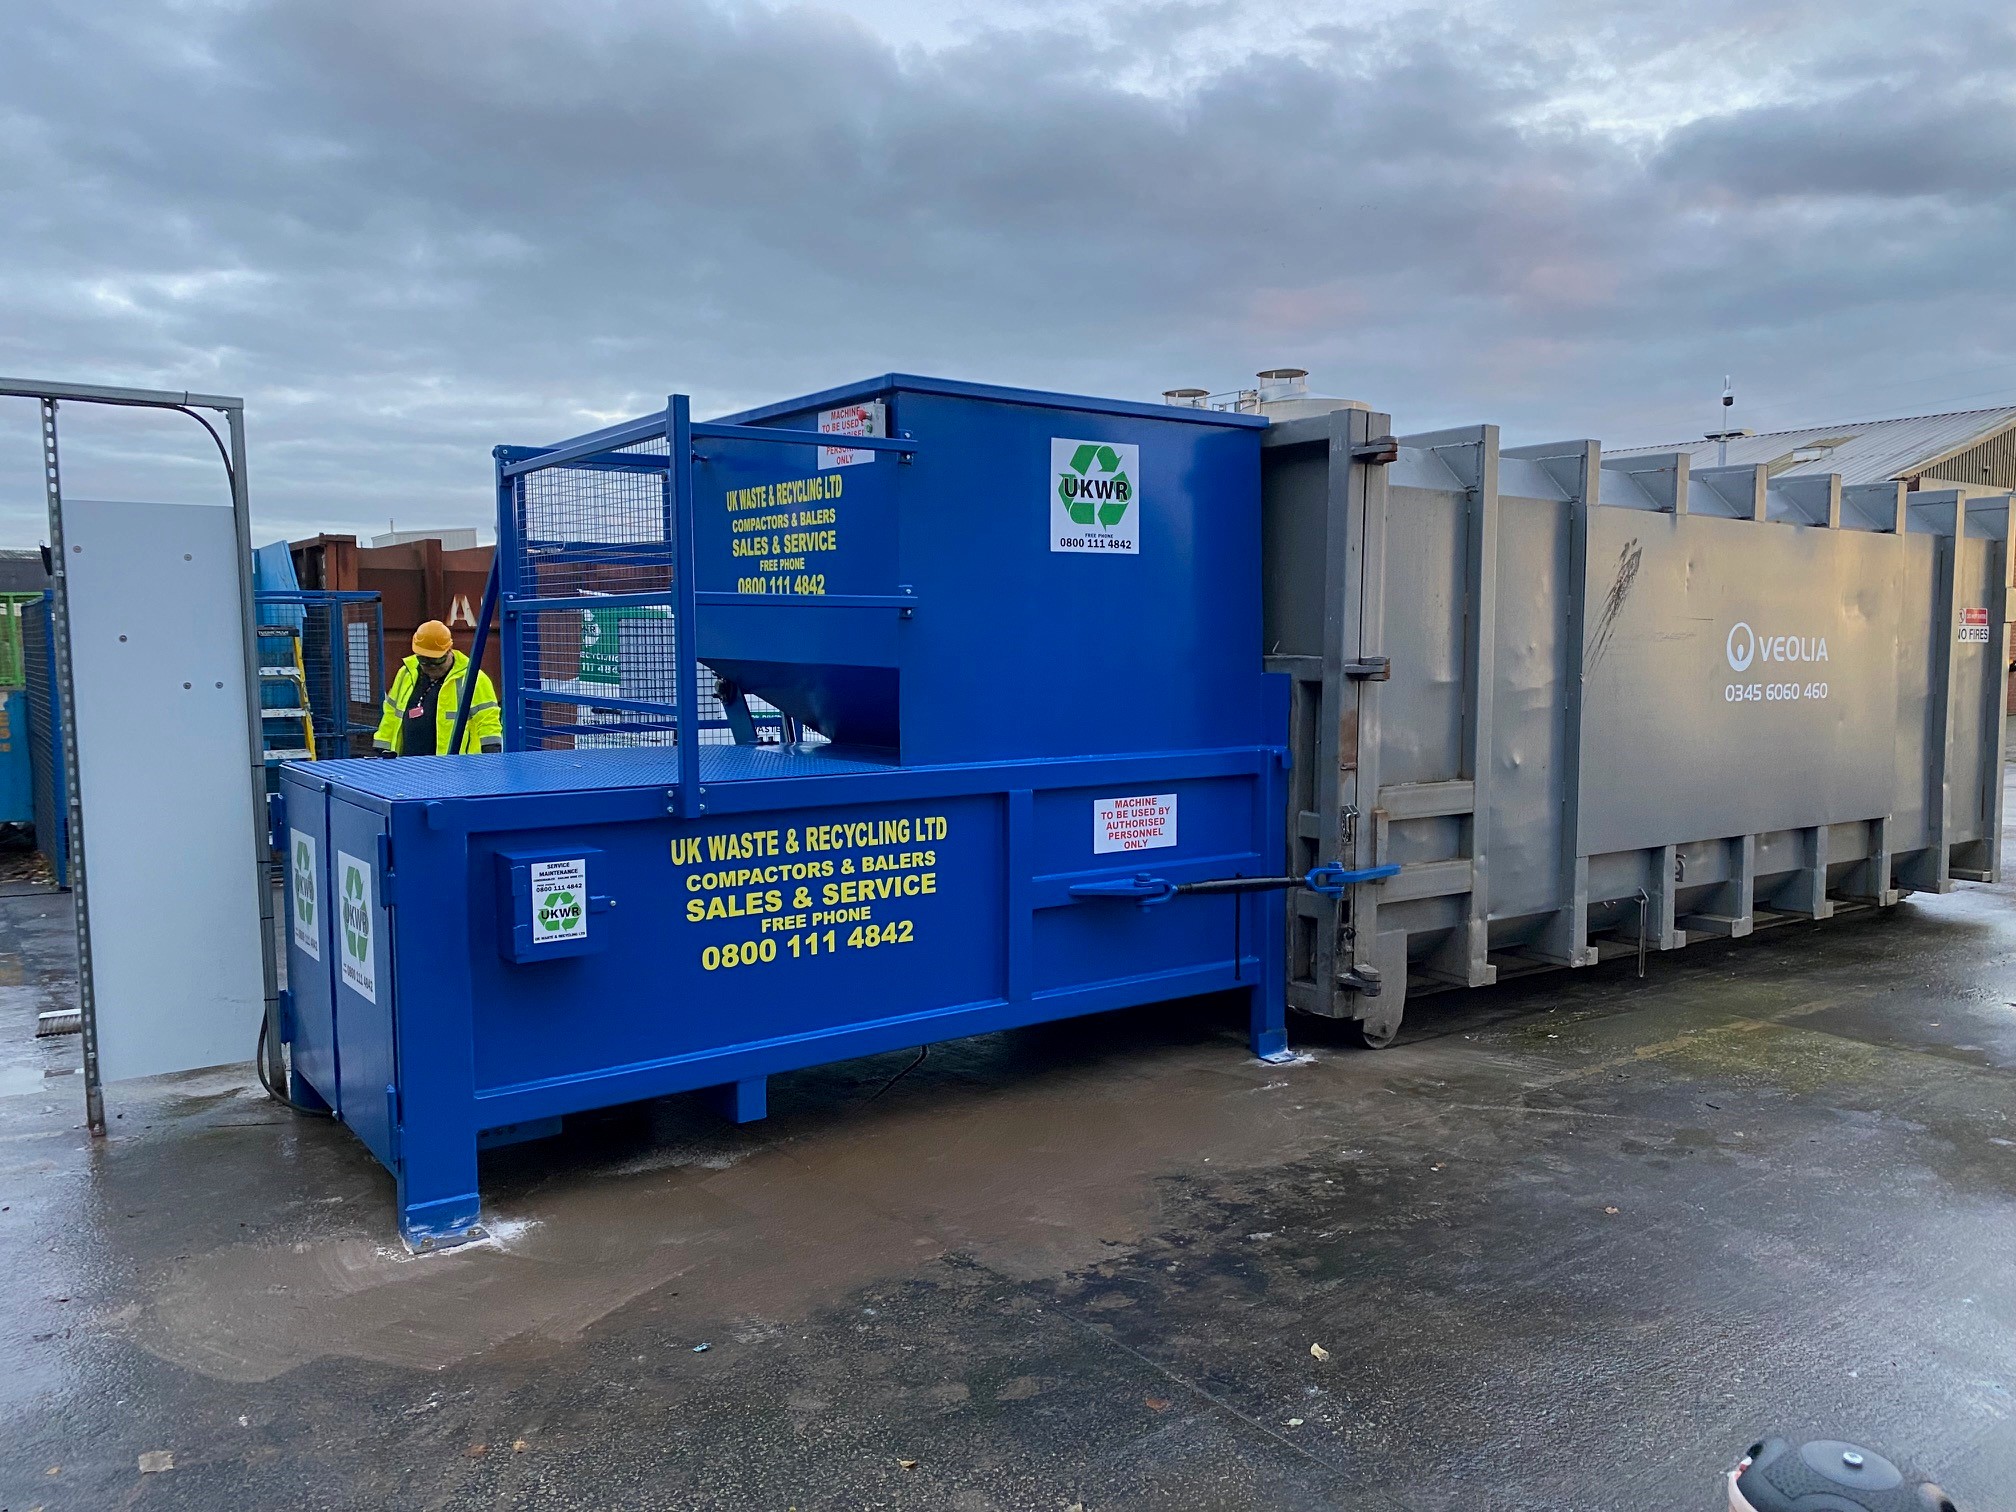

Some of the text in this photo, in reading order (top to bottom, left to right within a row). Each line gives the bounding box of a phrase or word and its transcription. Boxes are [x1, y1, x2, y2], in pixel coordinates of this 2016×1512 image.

[822, 424, 830, 433] TO
[832, 422, 840, 431] BE
[842, 418, 858, 430] USED
[837, 454, 854, 465] ONLY
[726, 474, 842, 512] UK WASTE & RECYCLING LTD
[1064, 478, 1128, 500] UKWR
[732, 508, 836, 533] COMPACTORS & BALERS
[732, 530, 836, 557] SALES & SERVICE
[1060, 538, 1131, 549] 0800 111 4842
[760, 558, 805, 571] FREE PHONE
[738, 574, 825, 595] 0800 111 4842
[969, 629, 987, 640] FIRES
[1758, 636, 1829, 662] VEOLIA
[1725, 682, 1828, 702] 0345 6060 460
[1101, 806, 1170, 820] TO BE USED BY
[1115, 798, 1157, 808] MACHINE
[1106, 818, 1165, 830] AUTHORISED
[1108, 828, 1163, 840] PERSONNEL
[670, 816, 947, 866] UK WASTE & RECYCLING LTD
[1124, 839, 1148, 849] ONLY
[539, 869, 578, 877] MAINTENANCE
[686, 850, 936, 892] COMPACTORS & BALERS
[686, 873, 936, 922] SALES & SERVICE
[344, 901, 368, 936] UKWR
[541, 906, 580, 919] UKWR
[762, 906, 871, 933] FREE PHONE
[702, 920, 914, 971] 0800 111 4842
